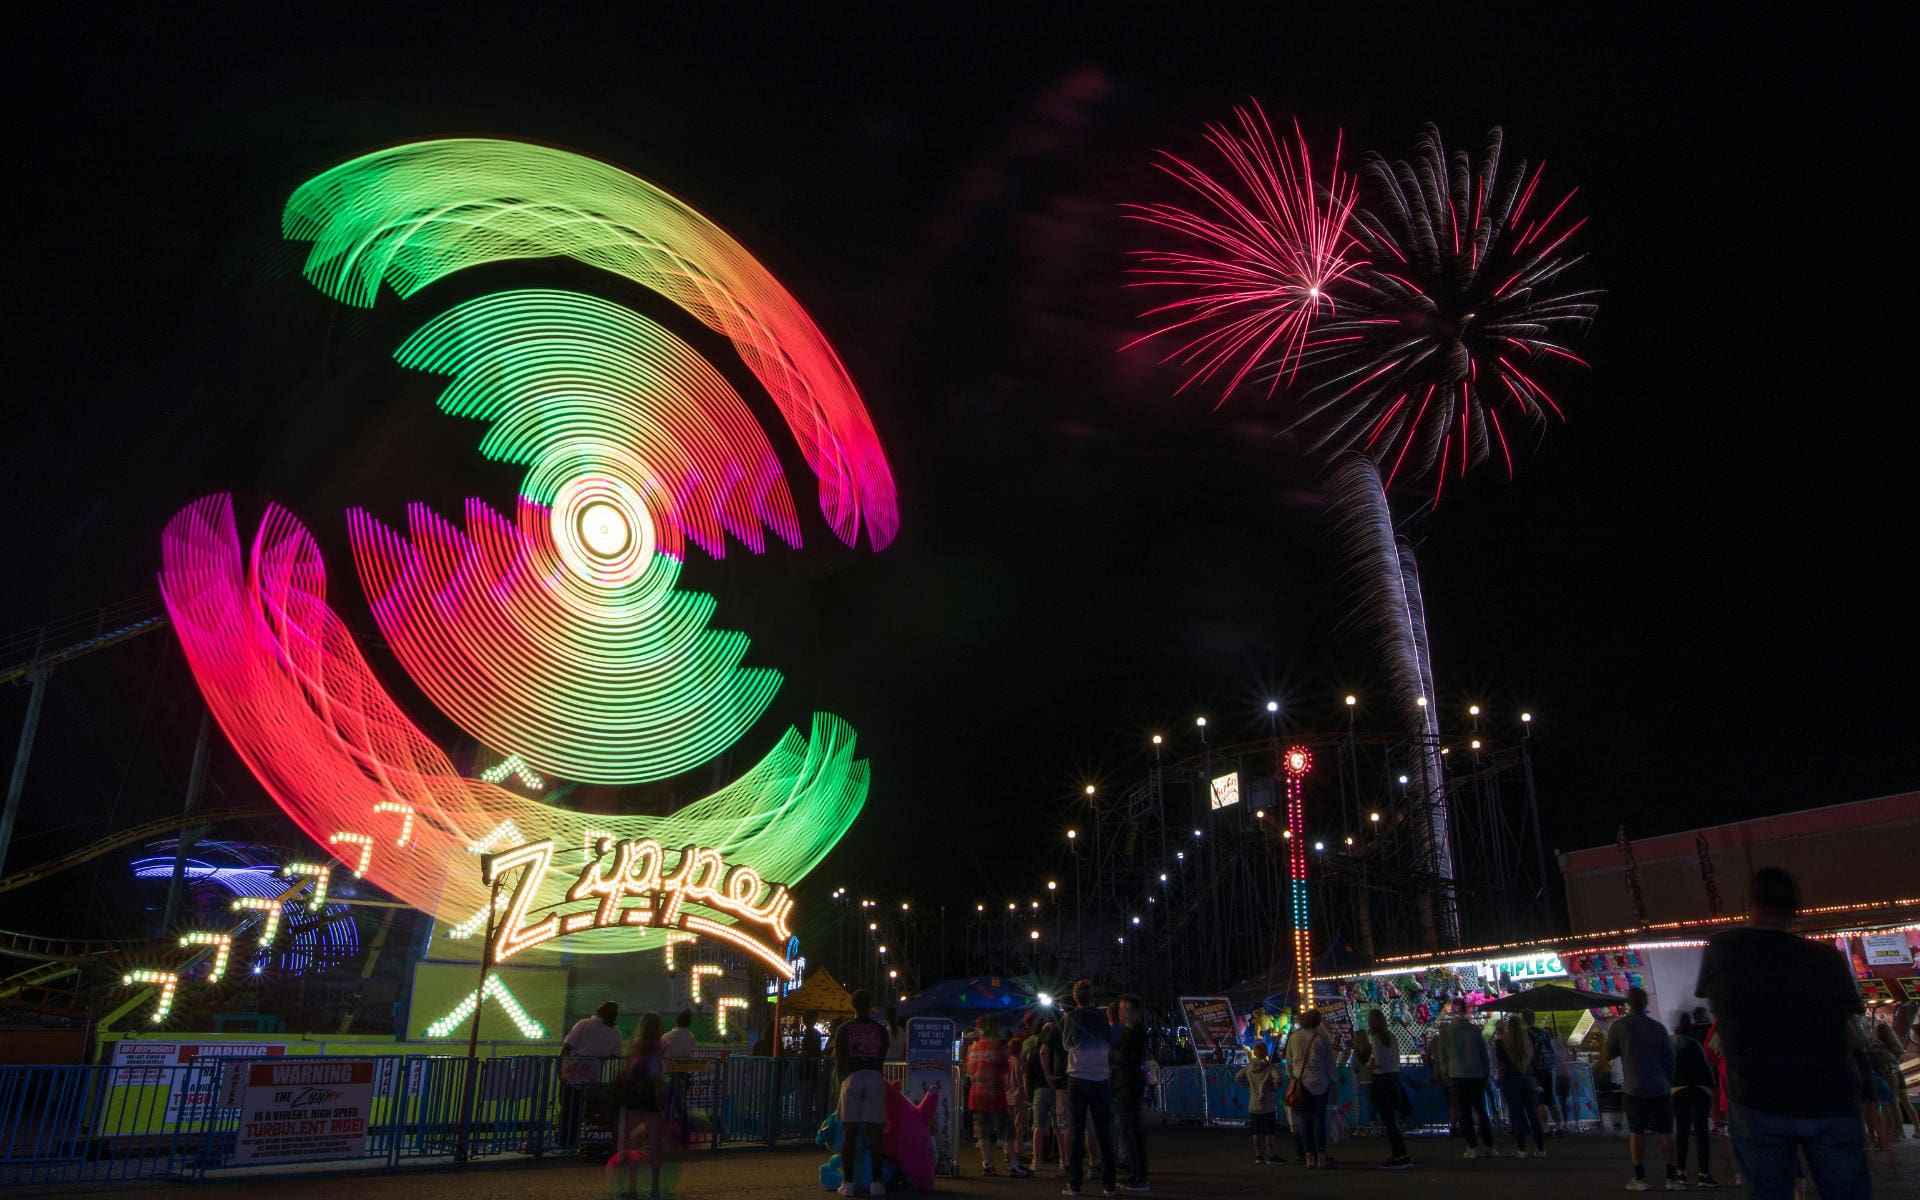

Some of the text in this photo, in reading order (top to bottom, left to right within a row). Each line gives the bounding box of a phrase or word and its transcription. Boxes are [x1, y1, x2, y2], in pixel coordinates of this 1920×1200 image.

[491, 838, 794, 963] Zipper
[272, 1064, 353, 1085] WARNING
[274, 1092, 293, 1103] THE
[254, 1112, 264, 1121] IS
[265, 1111, 271, 1121] A
[311, 1109, 331, 1119] HIGH
[333, 1107, 359, 1118] SPEED
[245, 1118, 364, 1138] TURBULENT RIDE!
